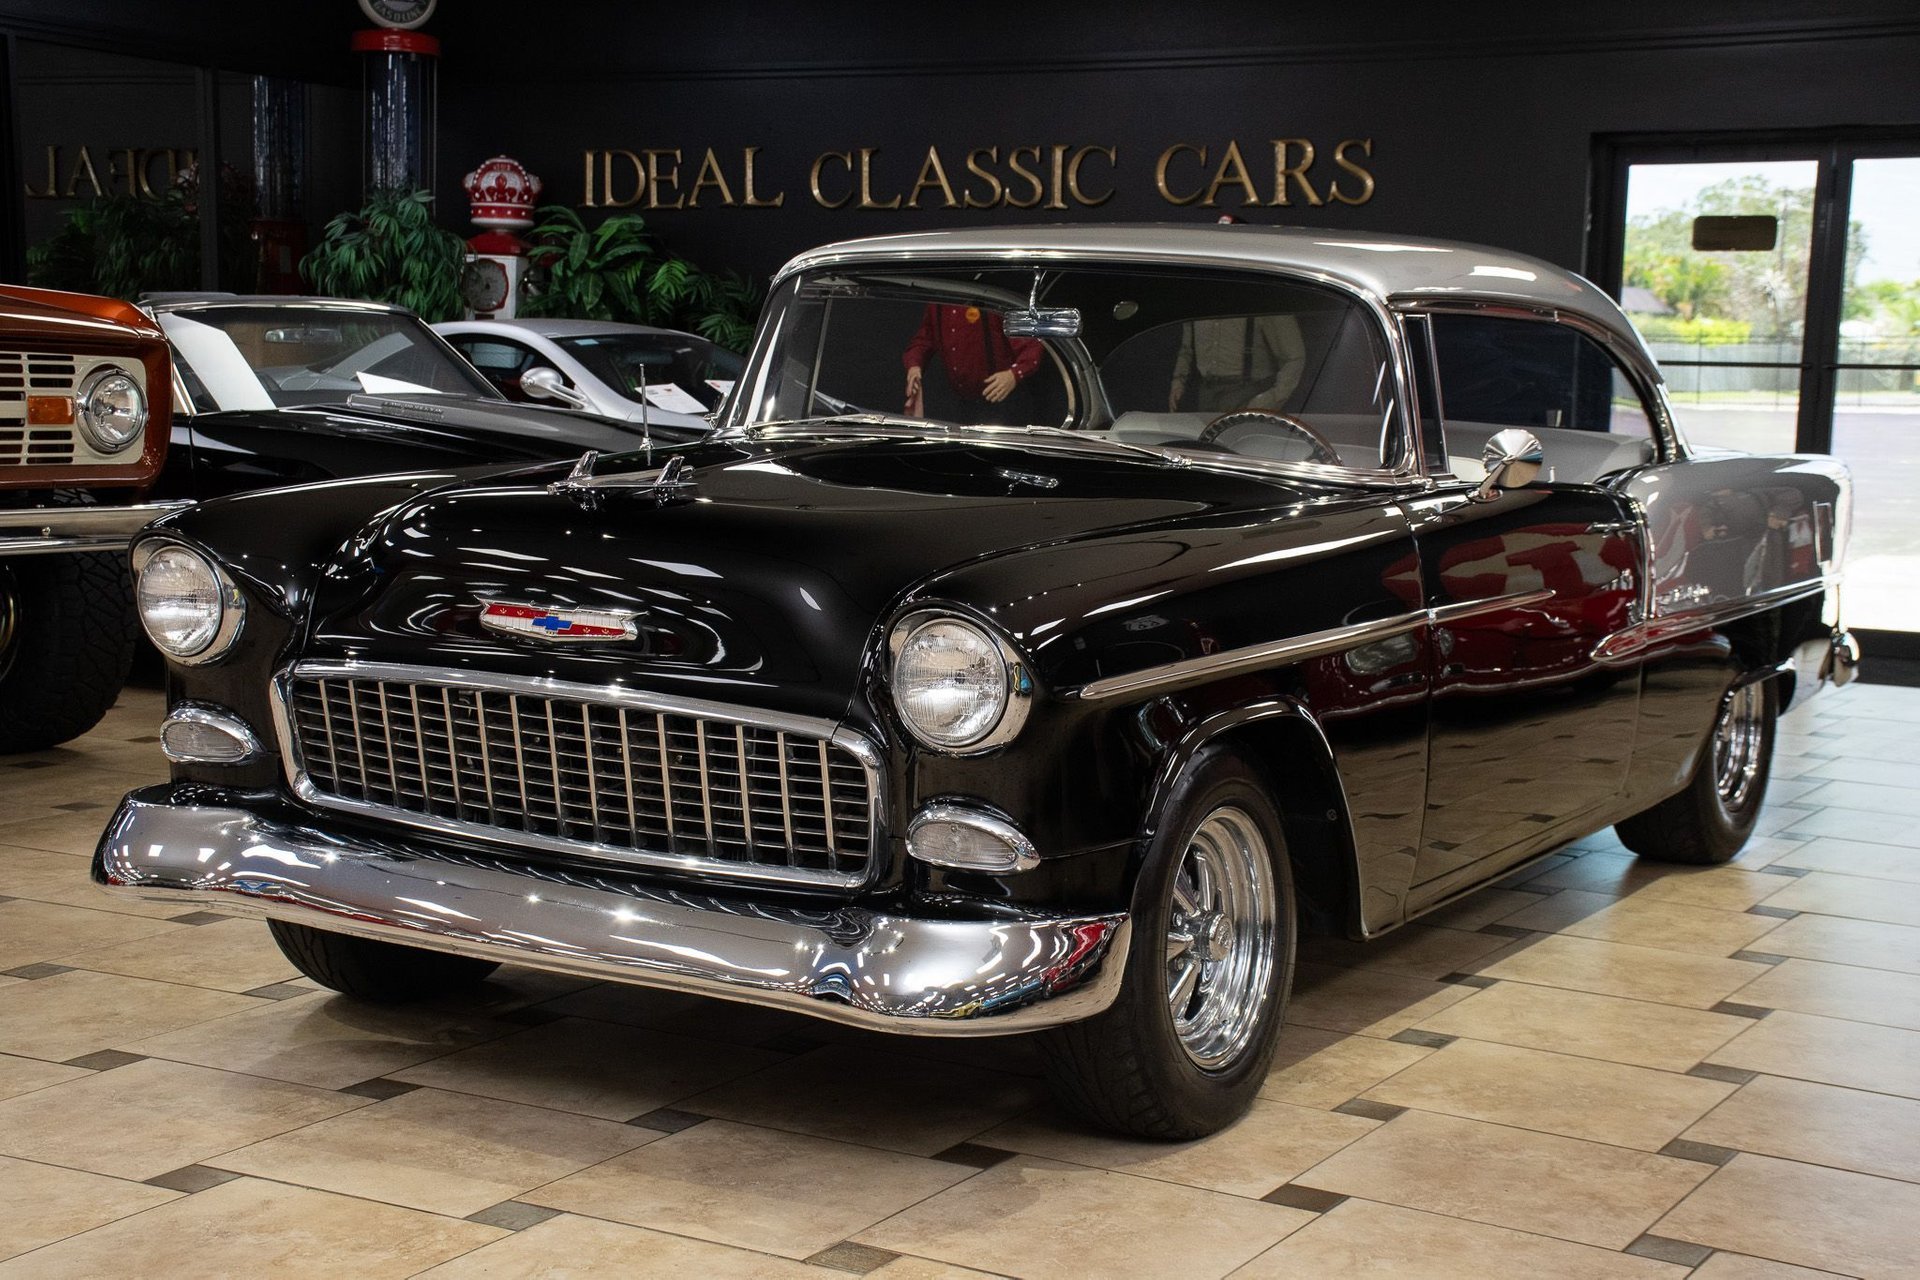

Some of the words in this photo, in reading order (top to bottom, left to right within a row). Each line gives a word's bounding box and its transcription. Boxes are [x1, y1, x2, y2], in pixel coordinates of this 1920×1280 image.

[579, 148, 784, 209] IDEAL
[810, 145, 1117, 210] CLASSIC
[1155, 138, 1376, 206] CARS
